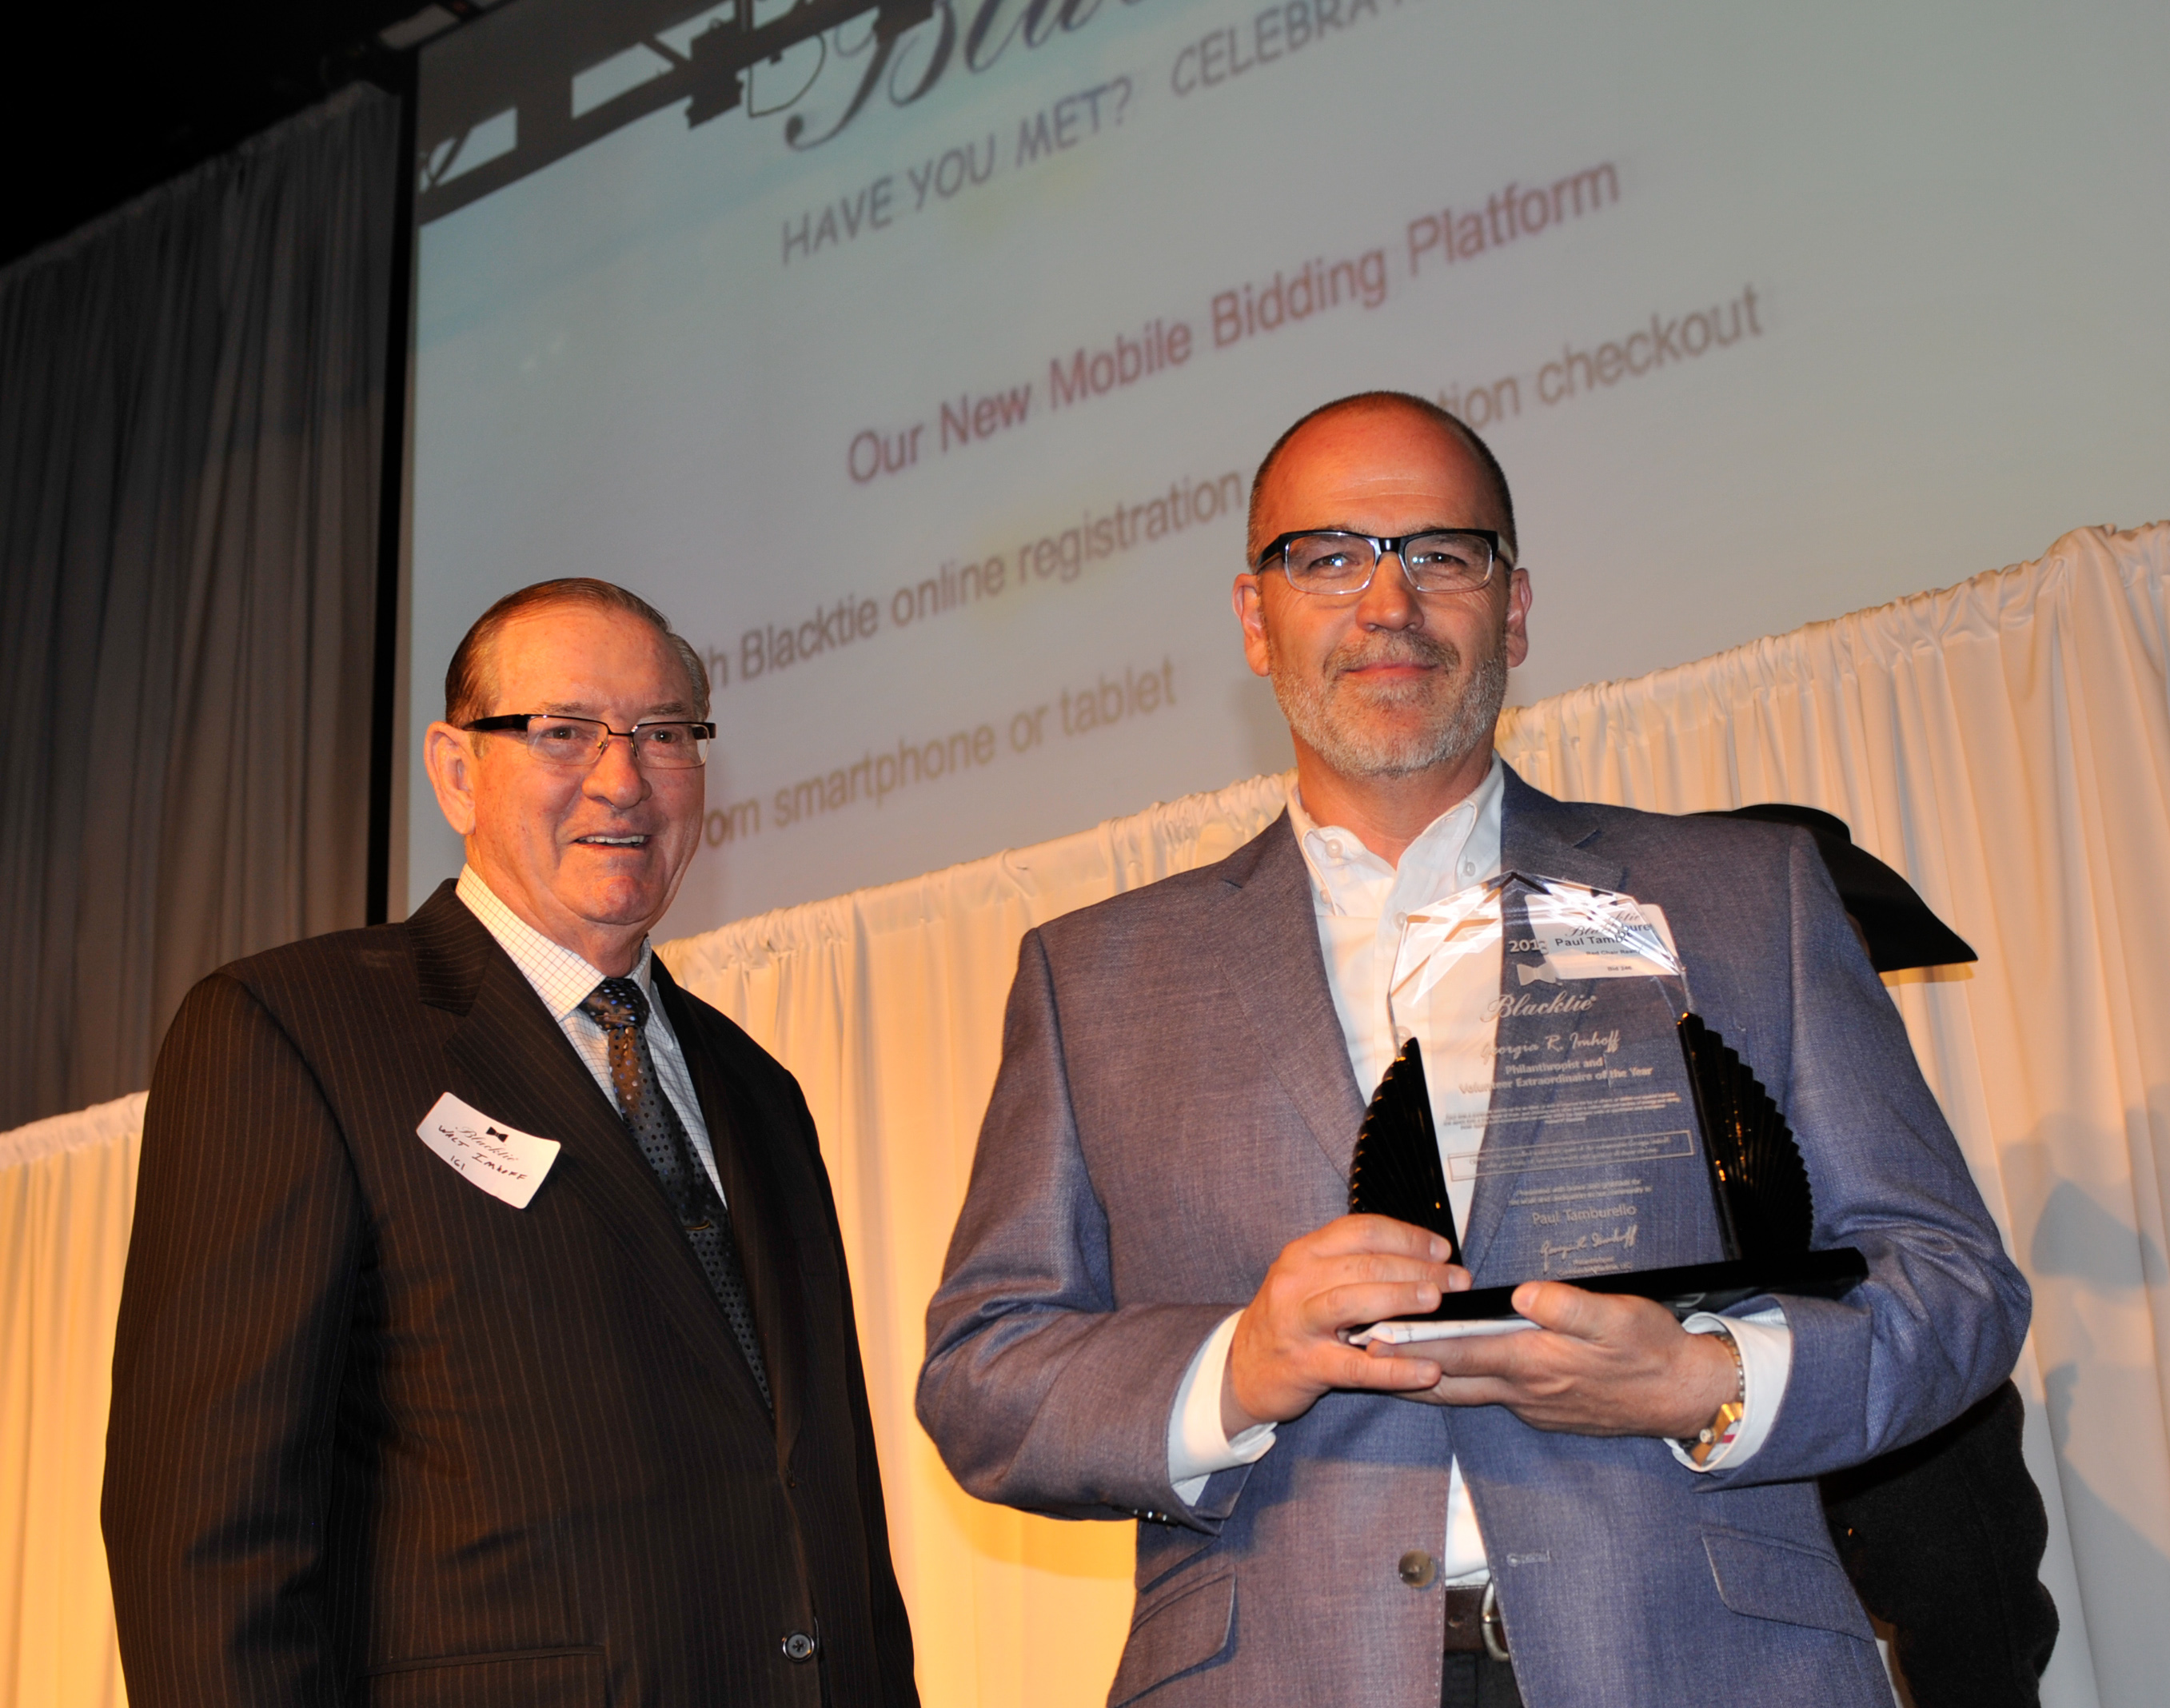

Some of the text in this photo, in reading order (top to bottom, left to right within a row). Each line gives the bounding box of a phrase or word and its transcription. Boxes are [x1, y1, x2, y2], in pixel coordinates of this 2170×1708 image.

[780, 0, 1404, 265] HAVE YOU MET? CELEBRA
[848, 162, 1621, 486] Our New Mobile Bidding Platform
[739, 589, 878, 683] Blacktie
[891, 553, 1006, 627] online
[1017, 470, 1242, 584] registration
[1537, 281, 1765, 405] checkout
[773, 725, 997, 829] smartphone
[1009, 705, 1048, 755] or
[1058, 656, 1177, 739] tablet
[1554, 935, 1585, 947] Paul
[1479, 991, 1594, 1023] Blacktie
[1570, 1028, 1621, 1053] Imhoff
[1459, 1066, 1653, 1095] Volunteer Extraordinaire of the Year
[1505, 1056, 1604, 1075] Philanthropist and
[1531, 1203, 1637, 1226] Paul Tamburello
